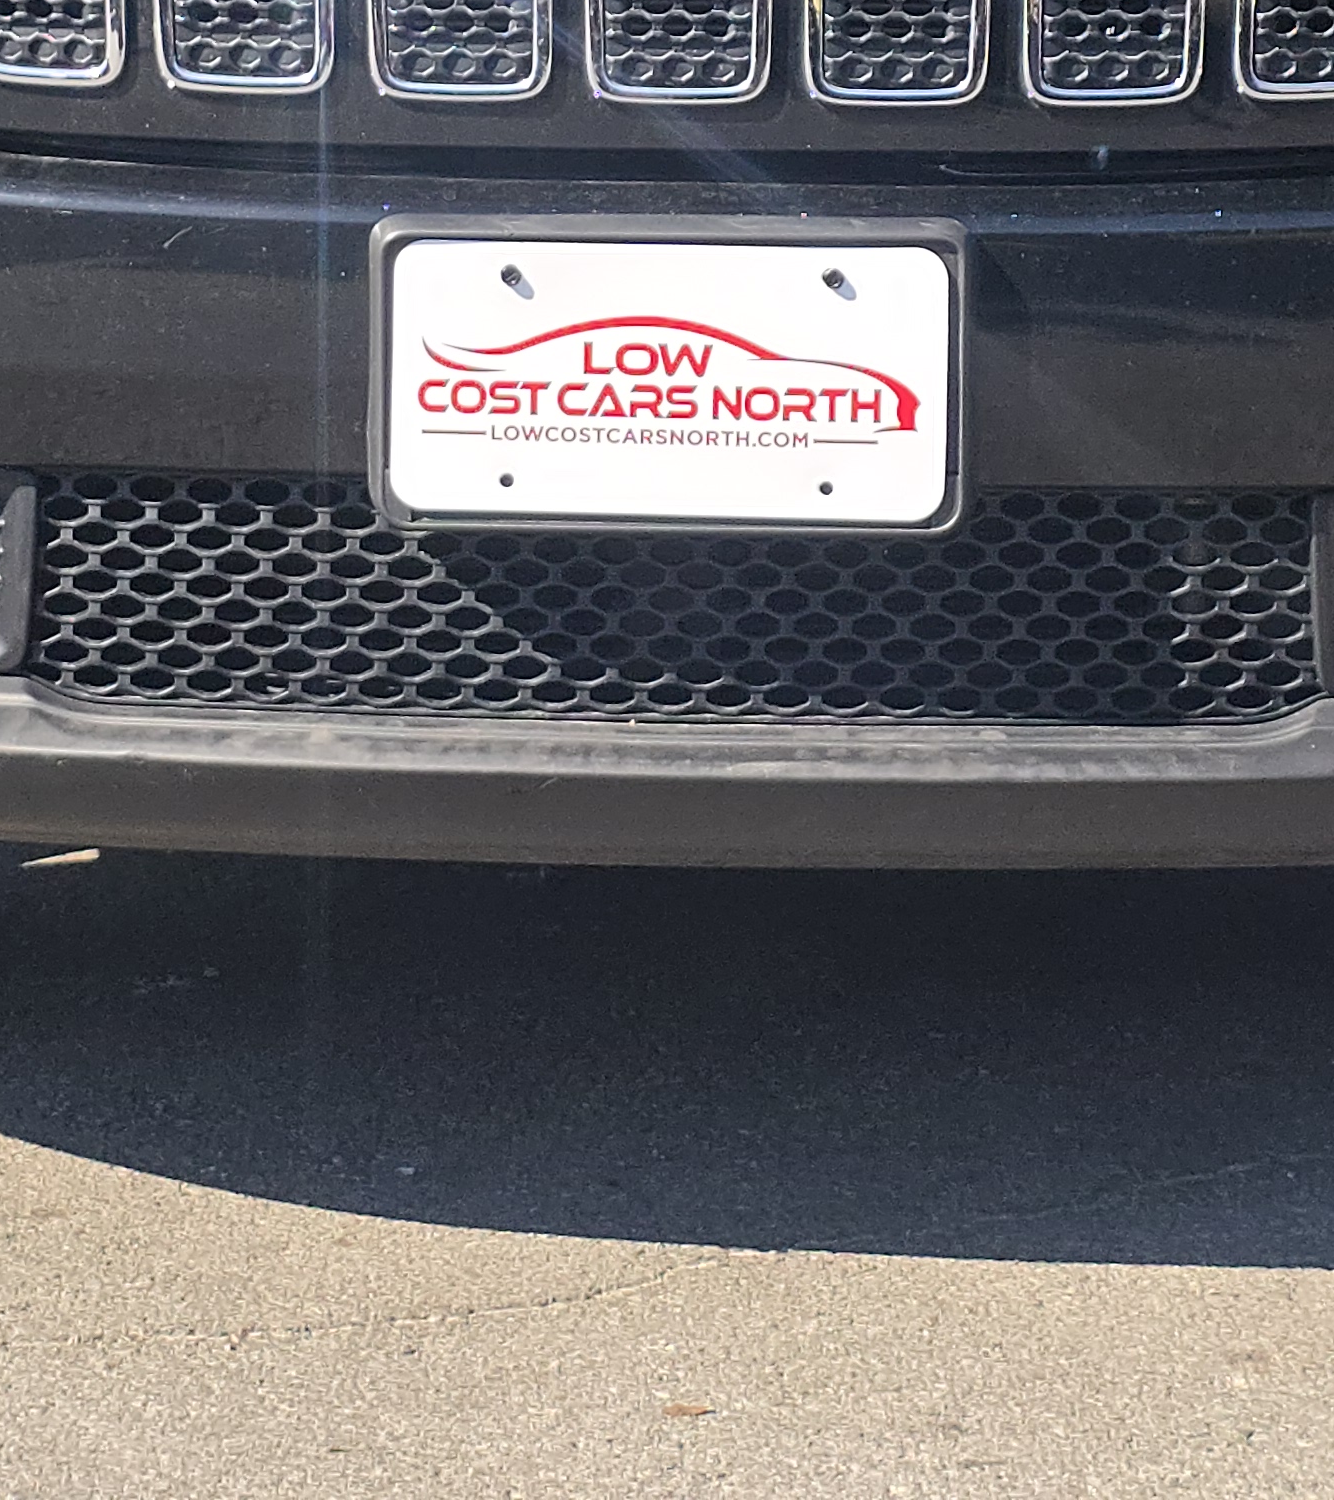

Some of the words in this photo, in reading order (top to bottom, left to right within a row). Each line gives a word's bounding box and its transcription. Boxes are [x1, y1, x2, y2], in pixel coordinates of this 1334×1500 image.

[582, 341, 713, 377] LOW
[417, 378, 551, 415] COST
[557, 381, 699, 419] CARS
[712, 386, 882, 424] NORTH
[490, 424, 810, 449] LOWCOSTCARSNORTH.COM
